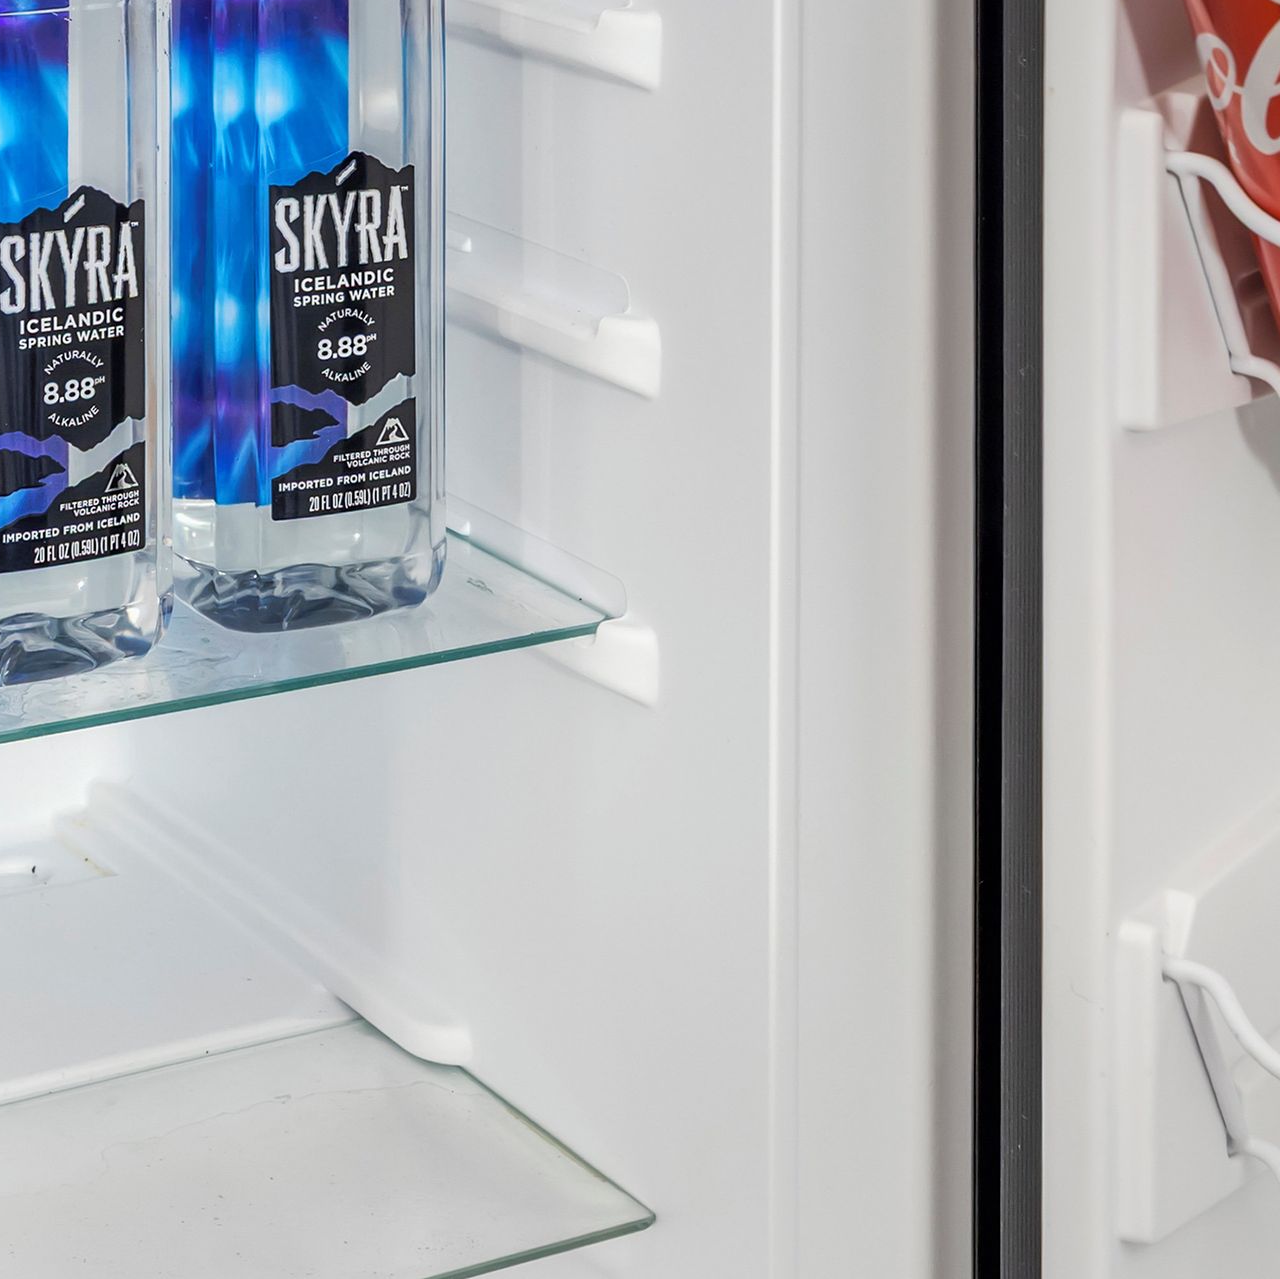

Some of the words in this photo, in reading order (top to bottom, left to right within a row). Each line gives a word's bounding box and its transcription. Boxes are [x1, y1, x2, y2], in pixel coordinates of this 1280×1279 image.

[294, 268, 395, 293] ICELANDIC
[293, 291, 345, 308] SPRING
[349, 285, 395, 301] WATER
[19, 307, 124, 335] ICELANDIC
[317, 307, 376, 333] NATURALLY
[18, 332, 72, 350] SPRING
[77, 325, 125, 343] WATER
[43, 349, 105, 376] NATURALLY
[321, 361, 372, 383] ALKALINE
[47, 404, 101, 427] ALKALINE
[333, 450, 371, 463] FILTERED
[373, 443, 410, 456] THROUGH
[346, 455, 388, 469] VOLCANIC
[389, 451, 410, 462] ROCK
[278, 475, 334, 492] IMPORTED
[337, 472, 366, 486] FROM
[369, 465, 411, 481] ICELAND
[59, 497, 100, 512] FILTERED
[102, 489, 140, 504] THROUGH
[73, 503, 117, 518] VOLCANIC
[118, 497, 140, 509] ROCK
[309, 496, 320, 513] 20
[321, 494, 331, 511] FL
[332, 492, 344, 509] OZ
[344, 489, 371, 509] (0.59L)
[381, 486, 391, 501] PT
[392, 485, 398, 499] 4
[398, 481, 411, 499] OZ)
[2, 527, 60, 544] IMPORTED
[63, 521, 94, 536] FROM
[97, 512, 141, 530] ICELAND
[34, 548, 46, 564] 20
[47, 545, 57, 562] FL
[58, 543, 70, 560] OZ
[71, 537, 99, 559] (0.59L)
[109, 533, 120, 551] PT
[121, 532, 126, 548] 4
[127, 529, 141, 547] OZ)
